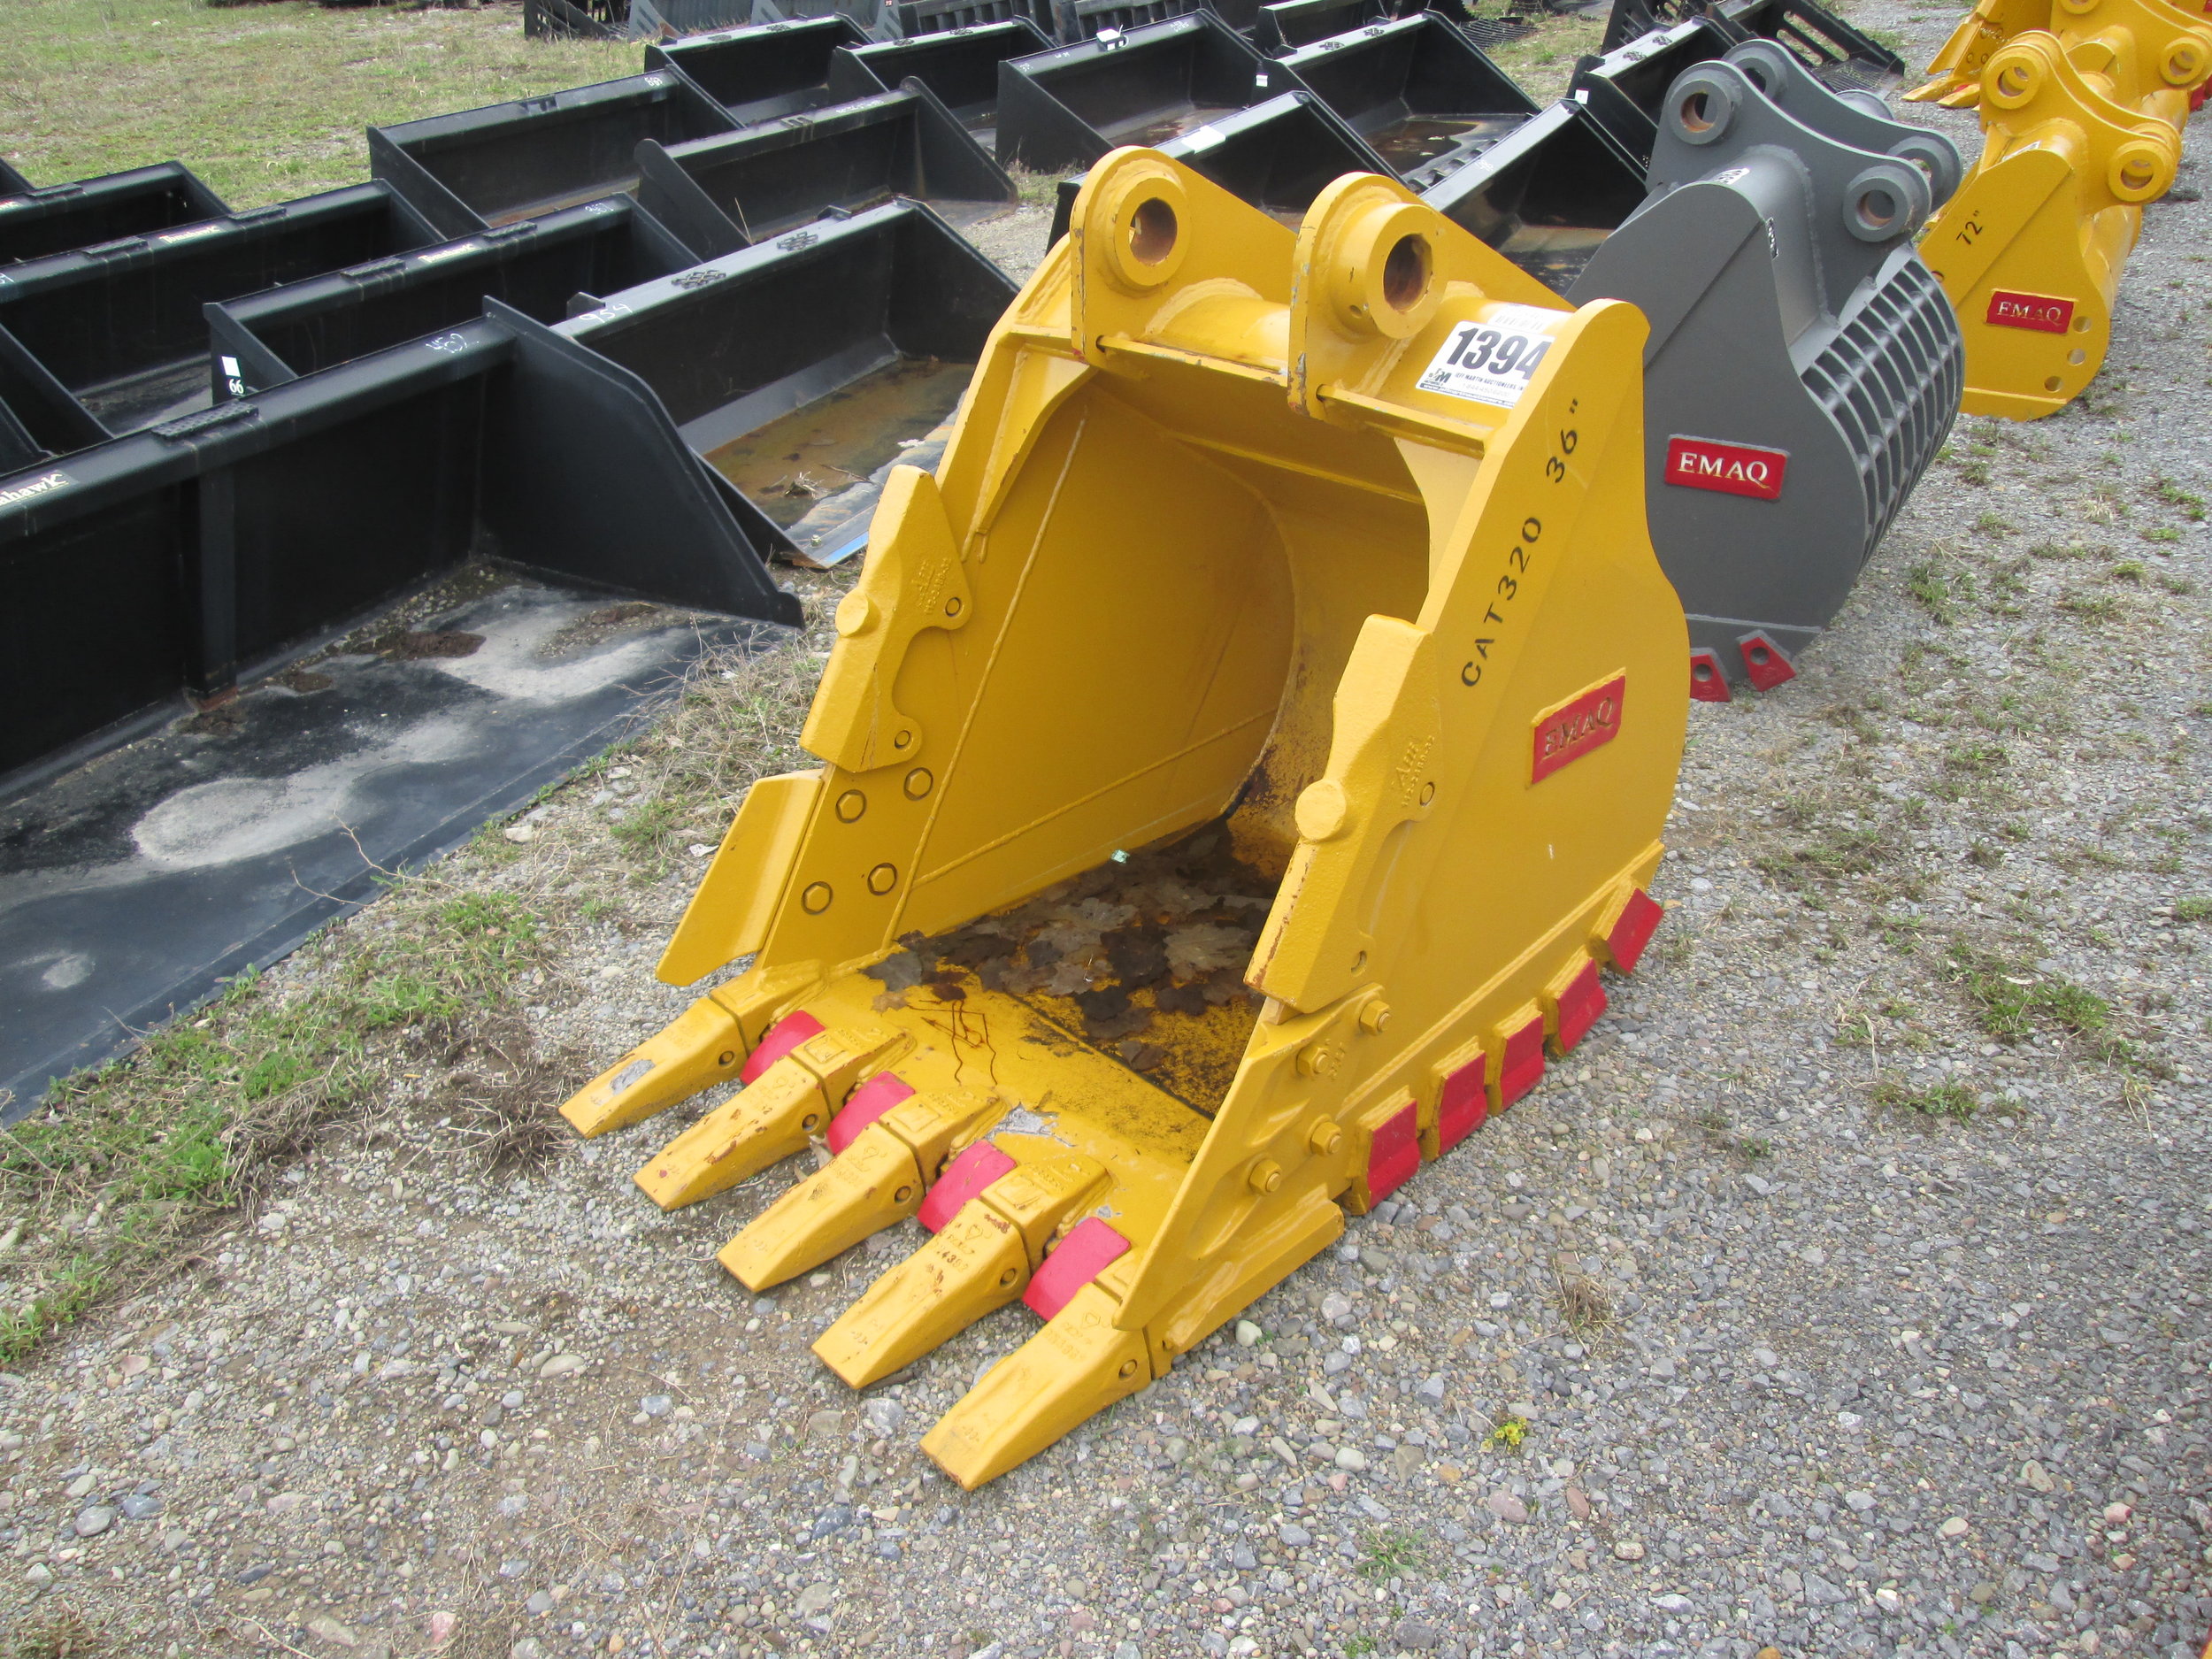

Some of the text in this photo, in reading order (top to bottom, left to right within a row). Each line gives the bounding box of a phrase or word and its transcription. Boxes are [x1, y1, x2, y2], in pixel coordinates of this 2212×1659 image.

[1956, 210, 1984, 245] 72"
[1997, 302, 2062, 326] EMAQ
[1447, 327, 1553, 380] 1394
[228, 378, 244, 395] 66
[1678, 452, 1770, 488] EMAQ
[1461, 516, 1542, 687] CAT320
[1544, 696, 1615, 756] EMAQ
